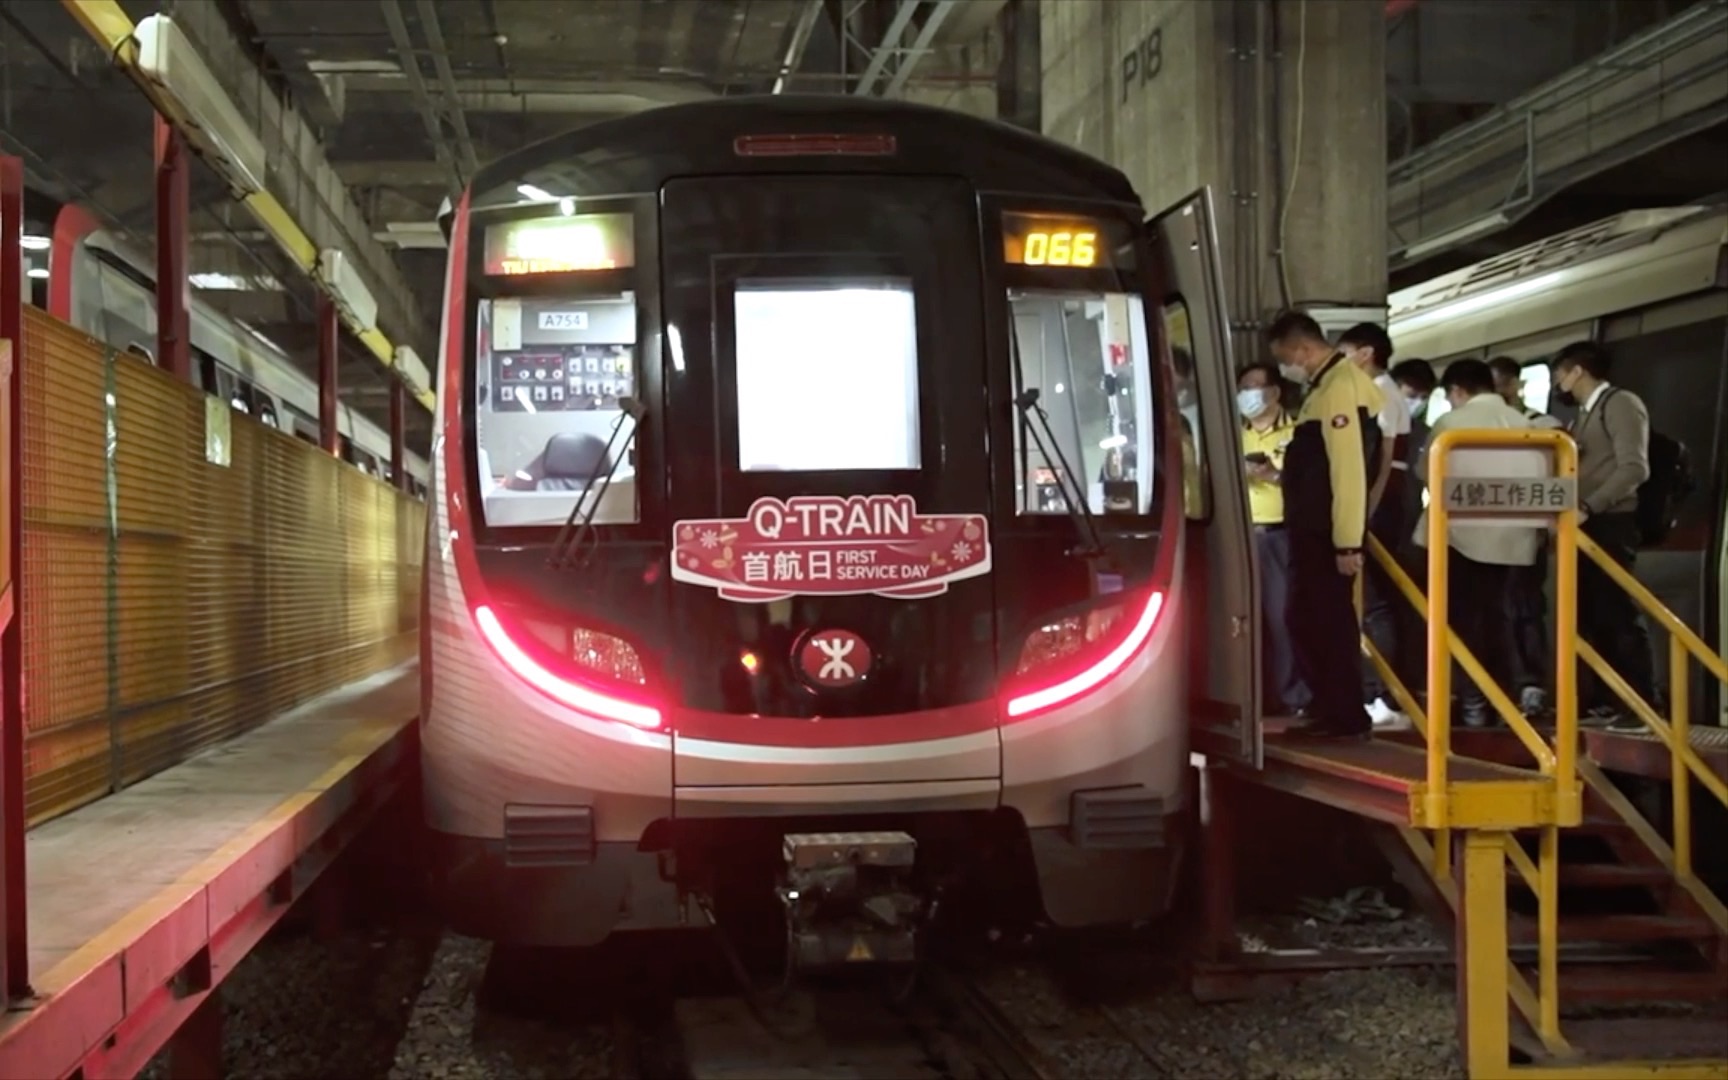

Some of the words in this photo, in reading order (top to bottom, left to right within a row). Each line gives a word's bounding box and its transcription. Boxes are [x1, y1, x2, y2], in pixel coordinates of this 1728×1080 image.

[1123, 26, 1162, 103] P18
[1024, 232, 1096, 266] 066
[544, 314, 581, 328] A754
[1450, 482, 1566, 507] 4號工作月台
[754, 502, 910, 539] Q-TRAIN
[741, 550, 831, 582] 首航日
[836, 550, 878, 564] FIRST
[836, 565, 899, 580] SERVICE
[901, 564, 930, 579] DAY
